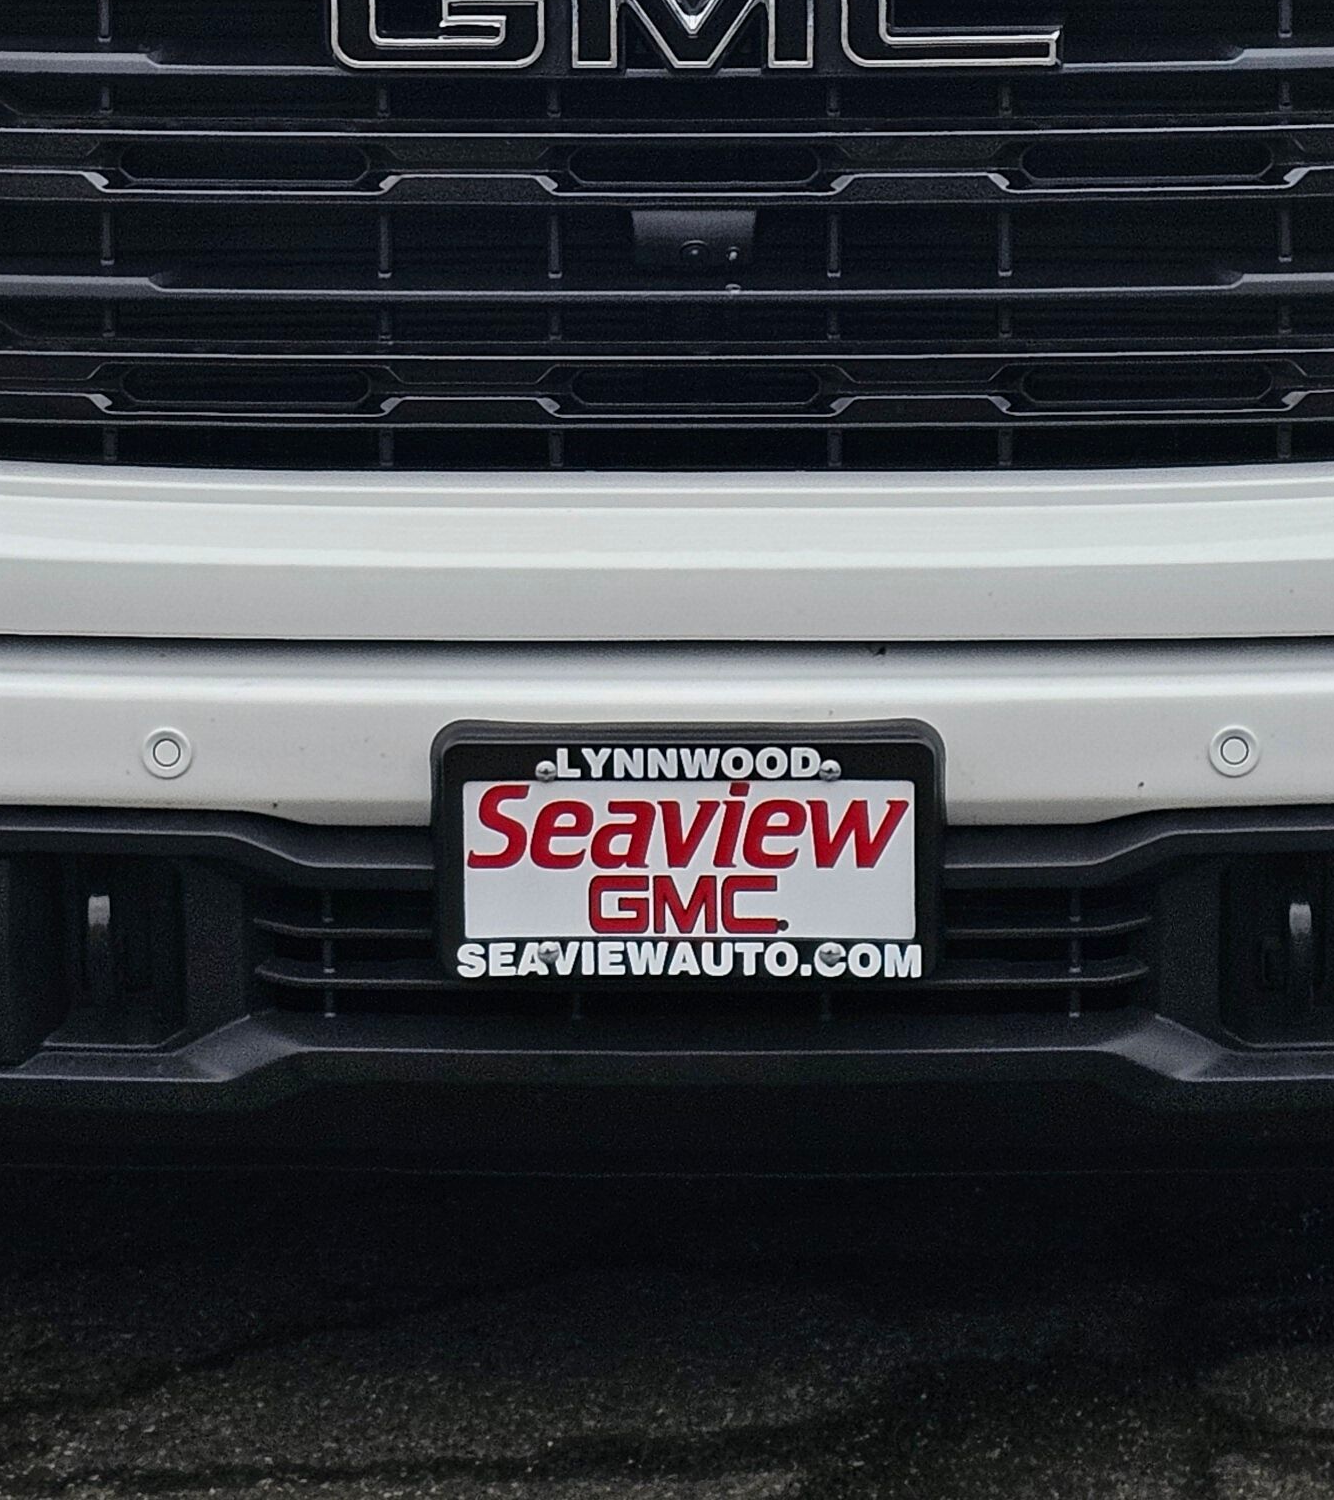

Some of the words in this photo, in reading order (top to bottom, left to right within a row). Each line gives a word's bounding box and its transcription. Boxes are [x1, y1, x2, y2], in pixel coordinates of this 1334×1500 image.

[555, 747, 821, 779] LYNNWOOD
[467, 781, 909, 869] Seaview
[588, 874, 780, 934] GMC
[456, 940, 923, 979] SEAVIEWAUTO.COM
